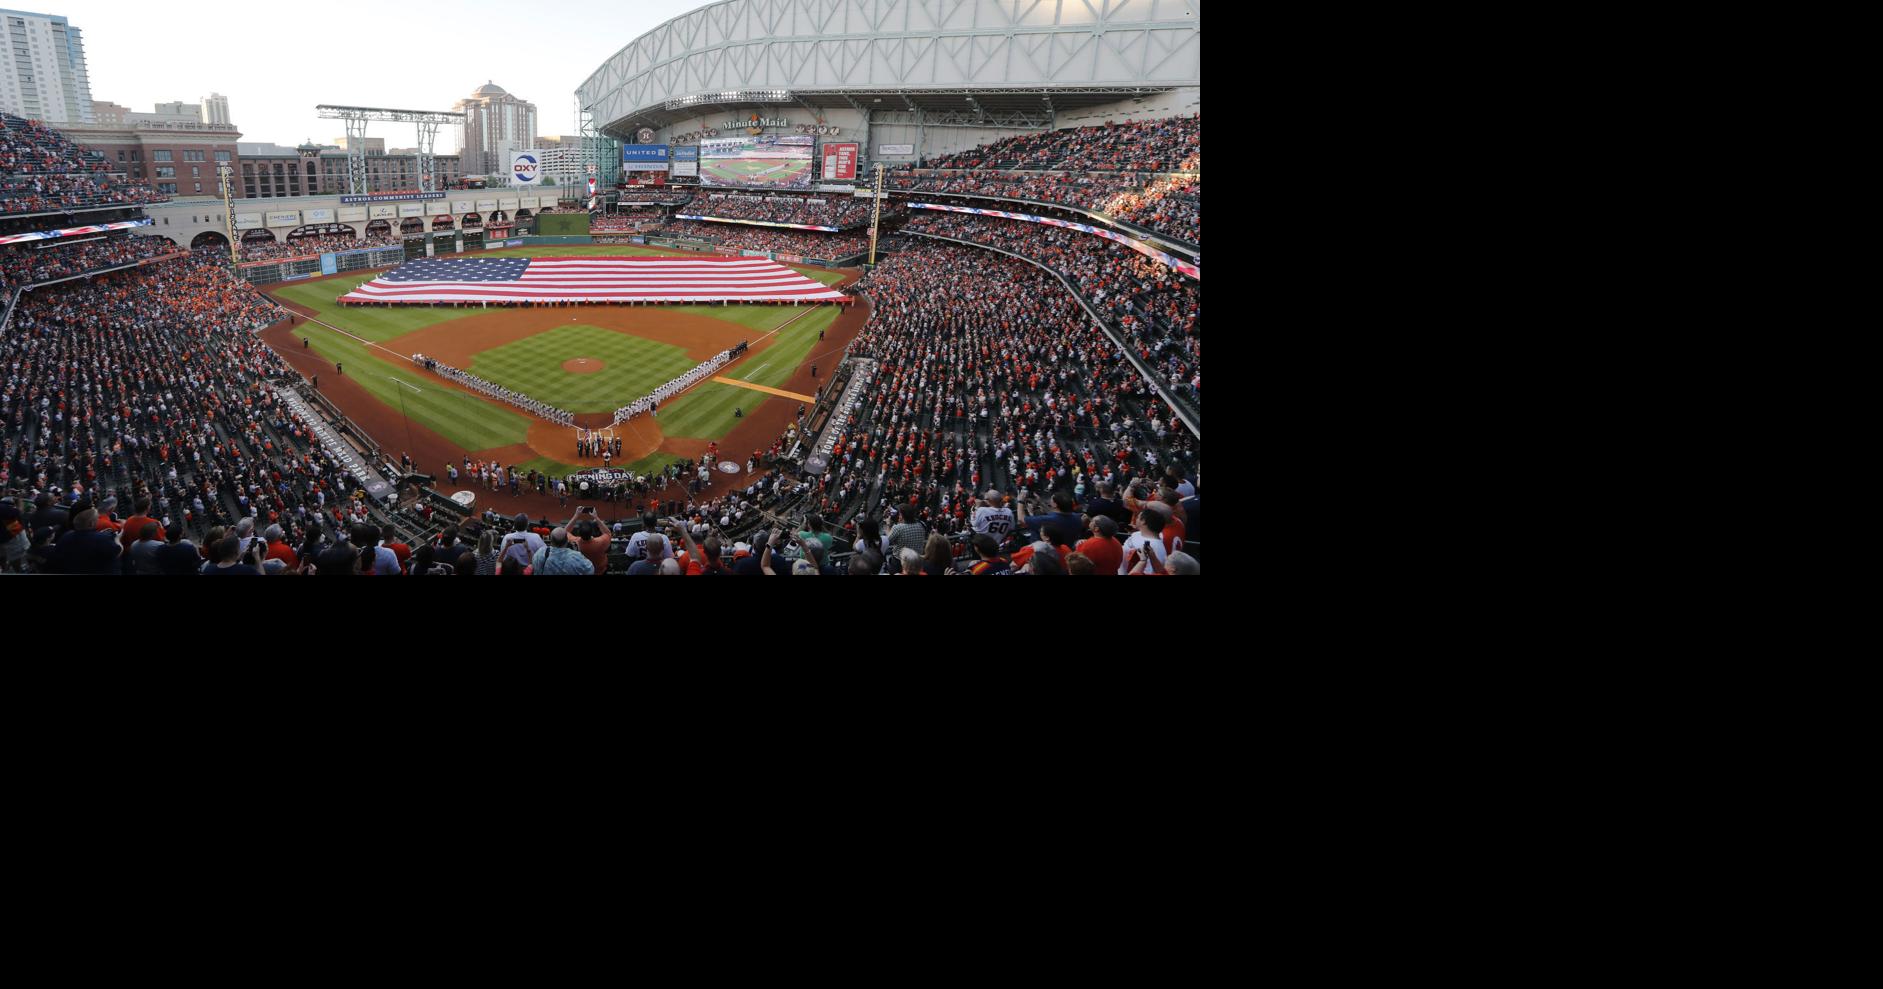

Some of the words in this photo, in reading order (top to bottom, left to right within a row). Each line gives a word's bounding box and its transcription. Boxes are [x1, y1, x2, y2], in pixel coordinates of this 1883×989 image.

[723, 119, 758, 130] Minute
[760, 118, 787, 127] Maid
[821, 435, 837, 454] HOME
[334, 446, 352, 463] MAID
[349, 463, 370, 482] PARK
[614, 471, 635, 480] DAY
[988, 522, 1009, 534] 60
